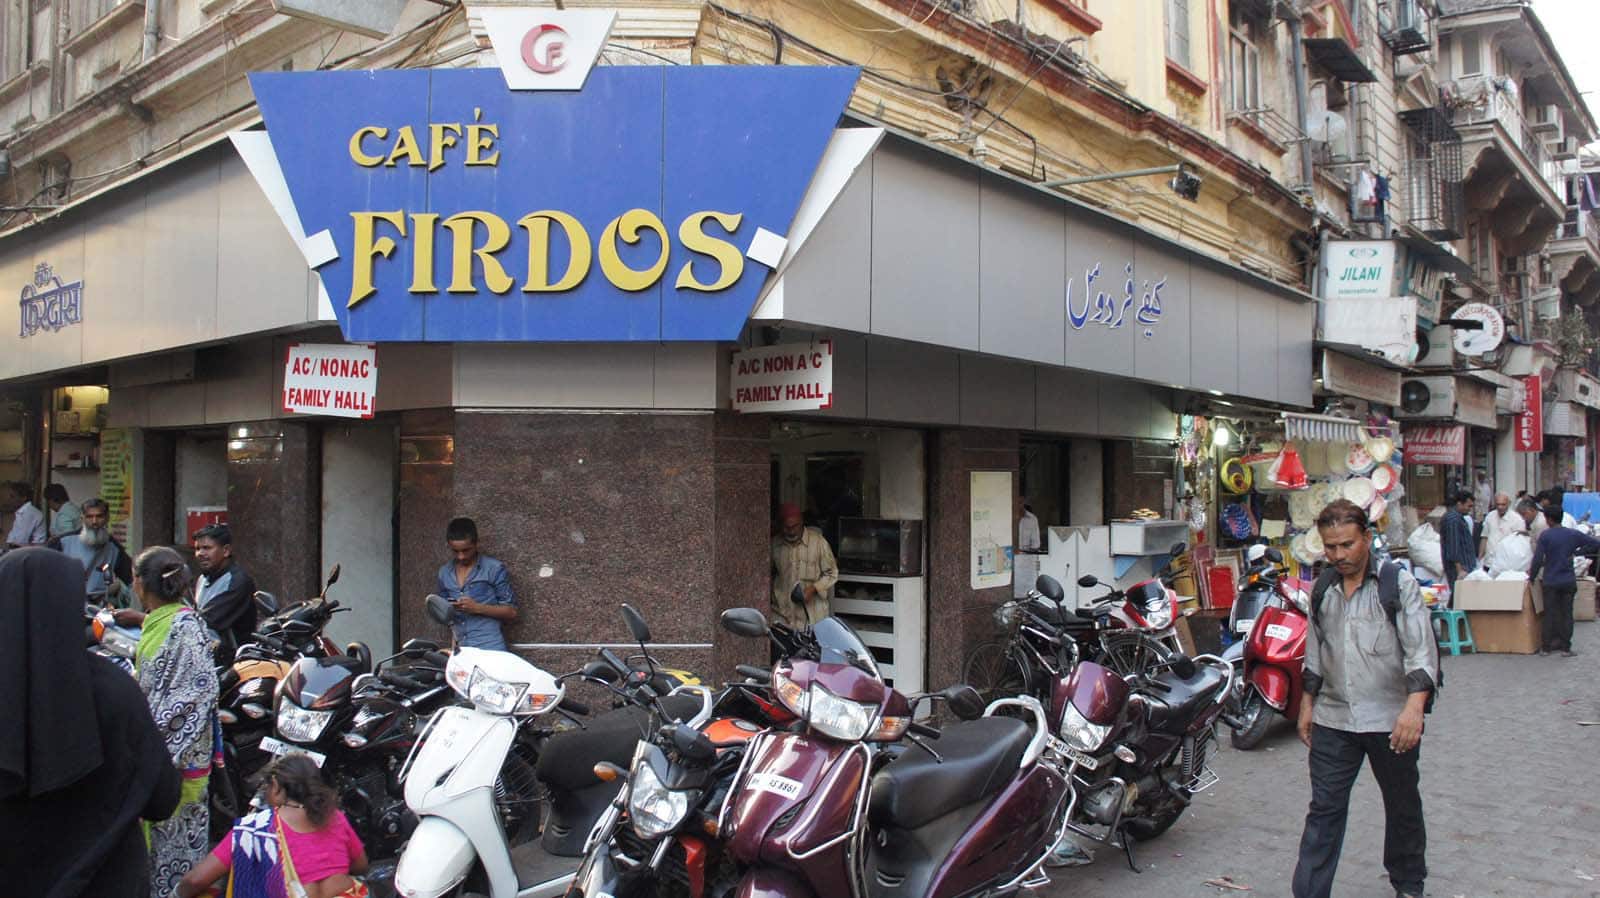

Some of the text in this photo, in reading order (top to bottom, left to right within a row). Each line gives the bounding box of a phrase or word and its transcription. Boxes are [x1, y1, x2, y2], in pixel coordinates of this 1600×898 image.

[349, 107, 500, 172] CAFÉ
[347, 208, 744, 308] FIRDOS
[1340, 266, 1382, 281] JILANI
[764, 355, 793, 373] NON
[288, 388, 369, 410] FAMILY HALL
[736, 383, 823, 403] FAMILY HALL
